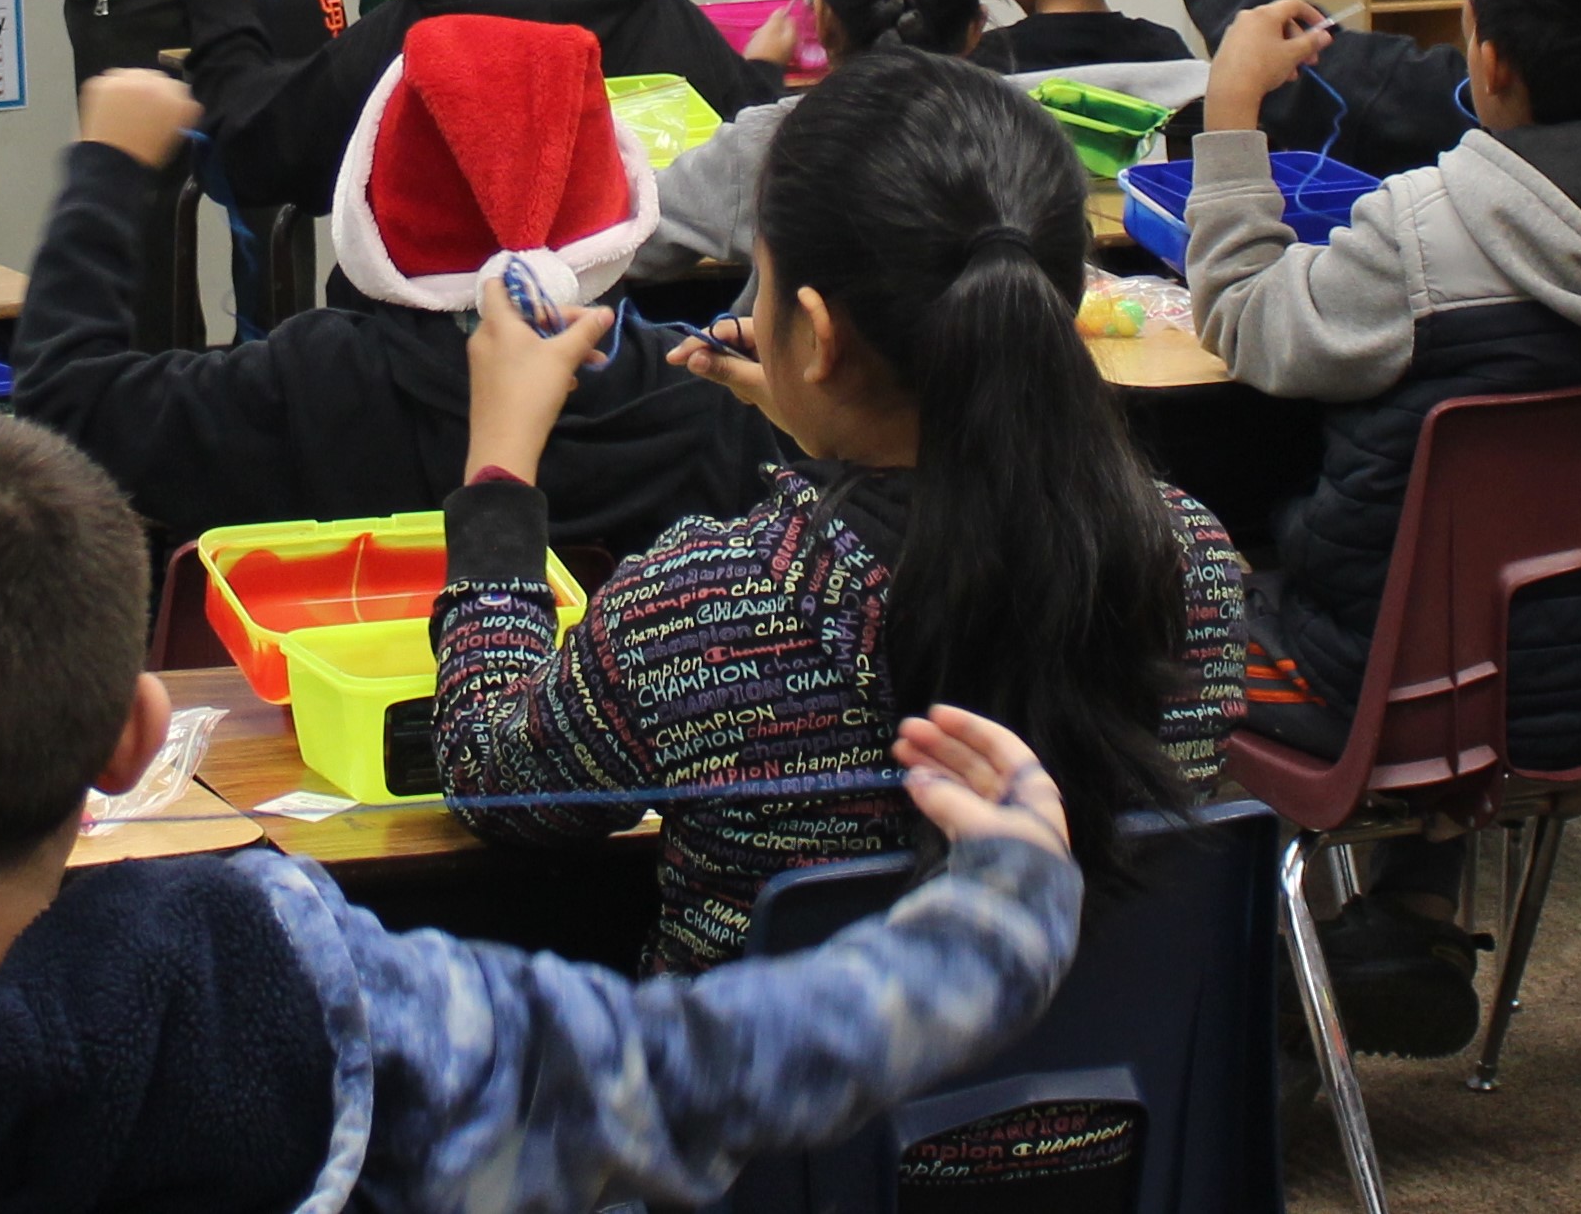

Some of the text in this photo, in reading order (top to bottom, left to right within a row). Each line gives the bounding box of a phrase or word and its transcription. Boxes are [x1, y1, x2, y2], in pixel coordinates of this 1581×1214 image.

[623, 584, 728, 623] champion
[623, 614, 696, 647] champion
[622, 654, 703, 691] hampion
[637, 659, 760, 708] CHAMPION
[786, 668, 844, 693] CHAM
[655, 704, 777, 750] CHAMPION
[746, 713, 838, 740] champion
[784, 745, 884, 776] champion
